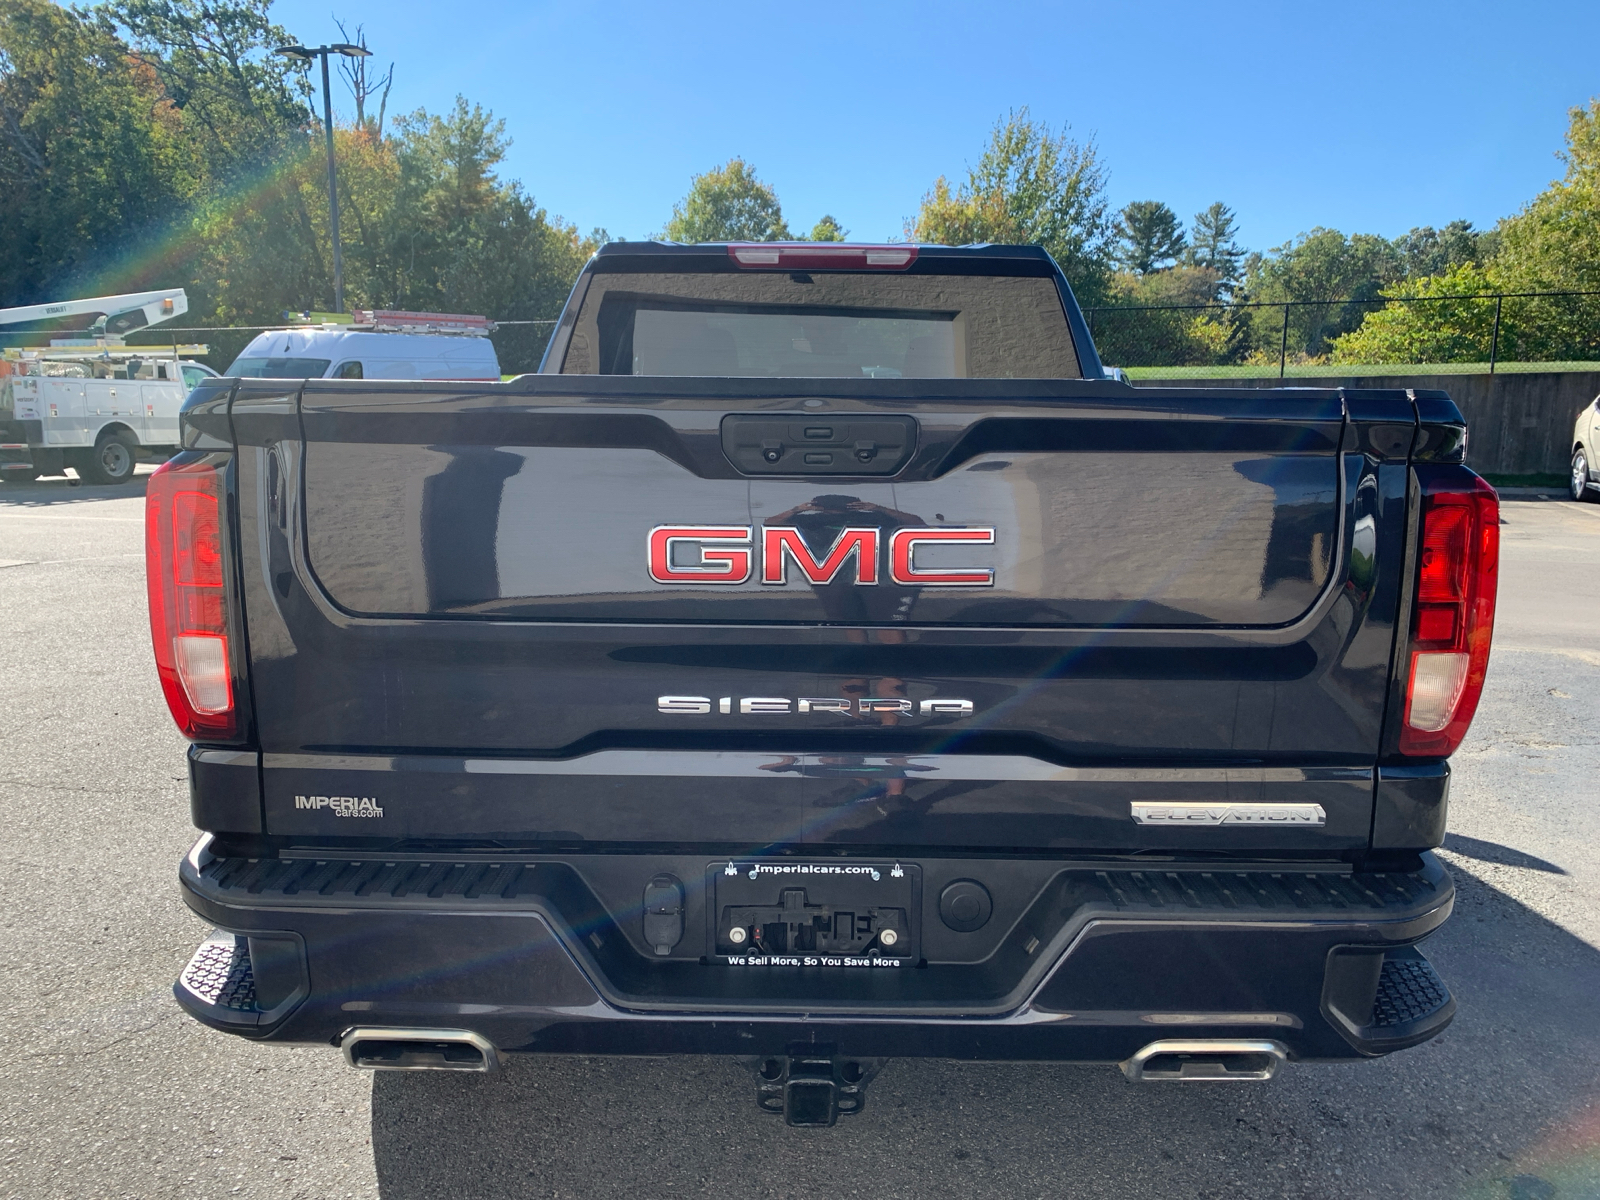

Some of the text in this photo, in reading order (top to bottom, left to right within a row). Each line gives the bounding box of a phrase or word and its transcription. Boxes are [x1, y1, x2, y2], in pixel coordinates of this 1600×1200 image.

[647, 525, 996, 587] GMC
[658, 696, 974, 717] SIERRA
[295, 796, 383, 810] IMPERIAL
[335, 809, 383, 817] cars.com
[1146, 807, 1312, 821] ELEVATION
[754, 864, 875, 875] Imperialcars.com
[728, 957, 900, 967] We Sell More, So You Save More
